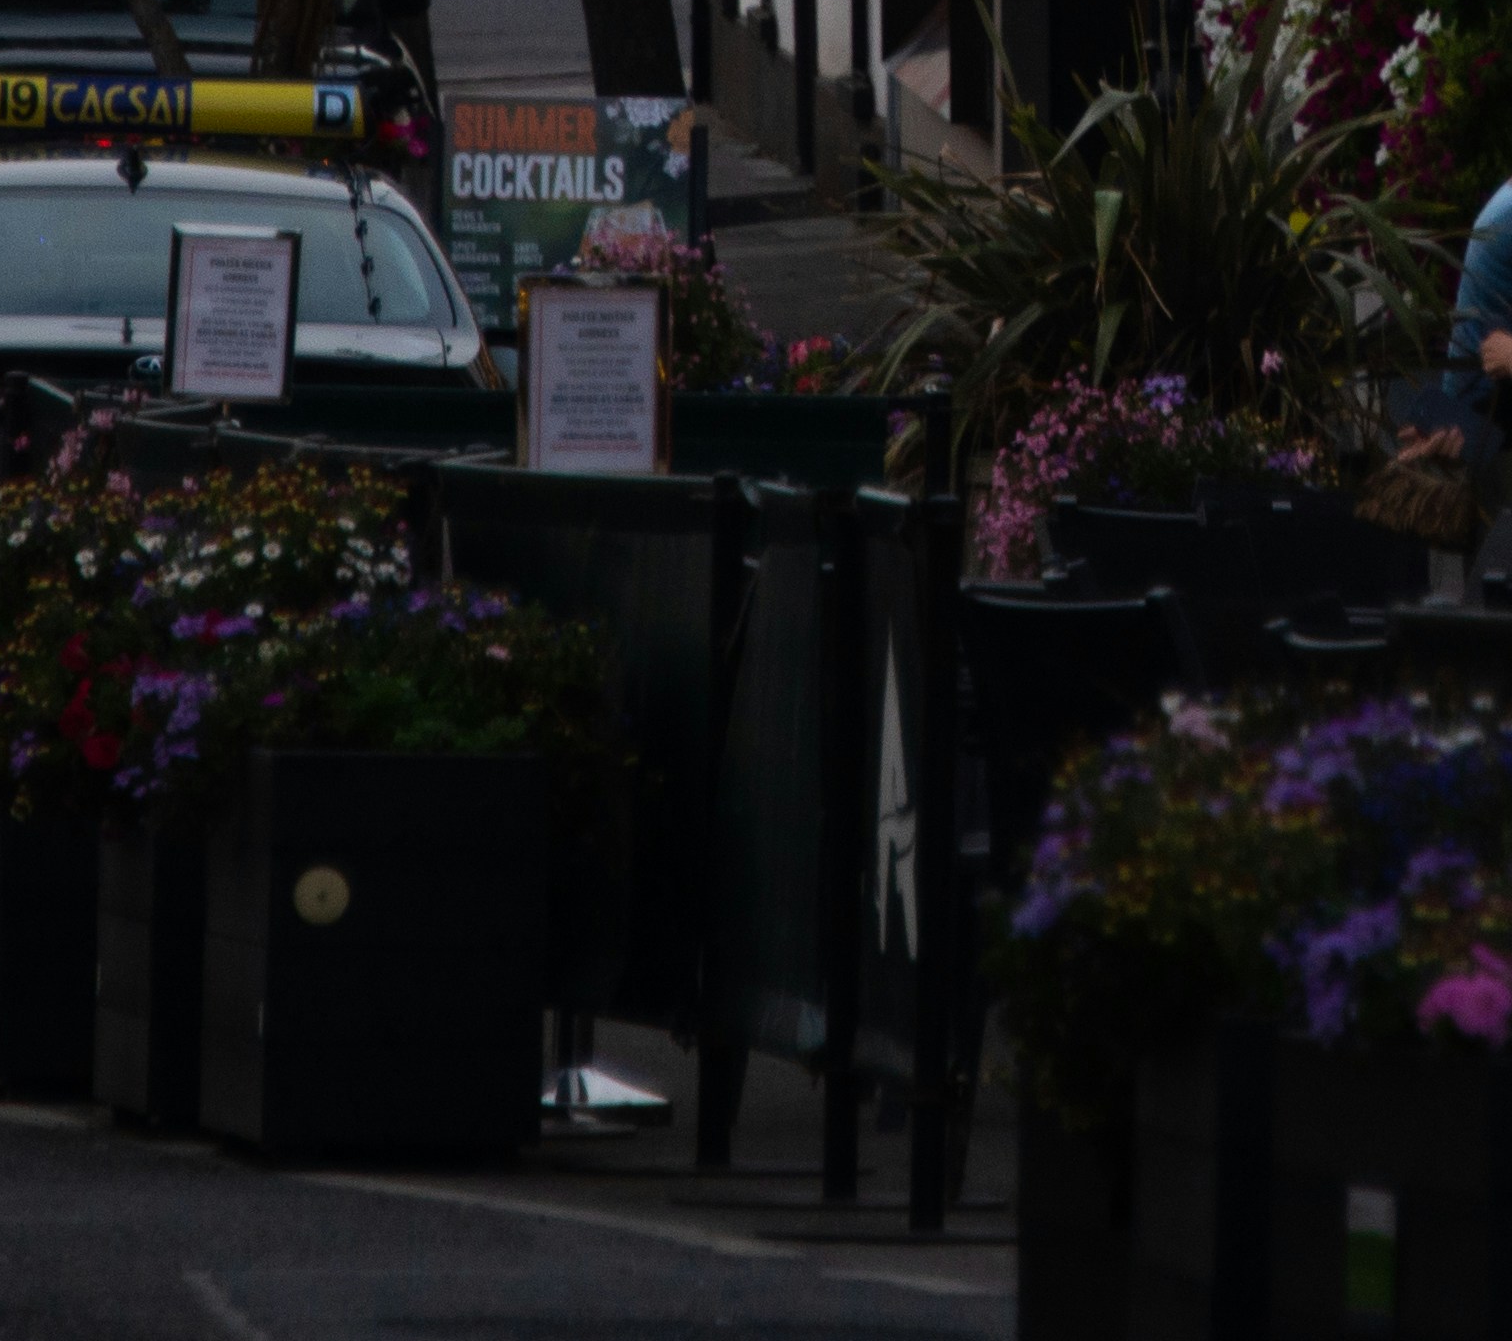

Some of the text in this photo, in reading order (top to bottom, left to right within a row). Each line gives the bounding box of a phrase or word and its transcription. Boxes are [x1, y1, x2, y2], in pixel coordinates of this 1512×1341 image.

[317, 90, 351, 127] D
[453, 103, 598, 153] SUMMER
[451, 152, 624, 201] COCKTAILS
